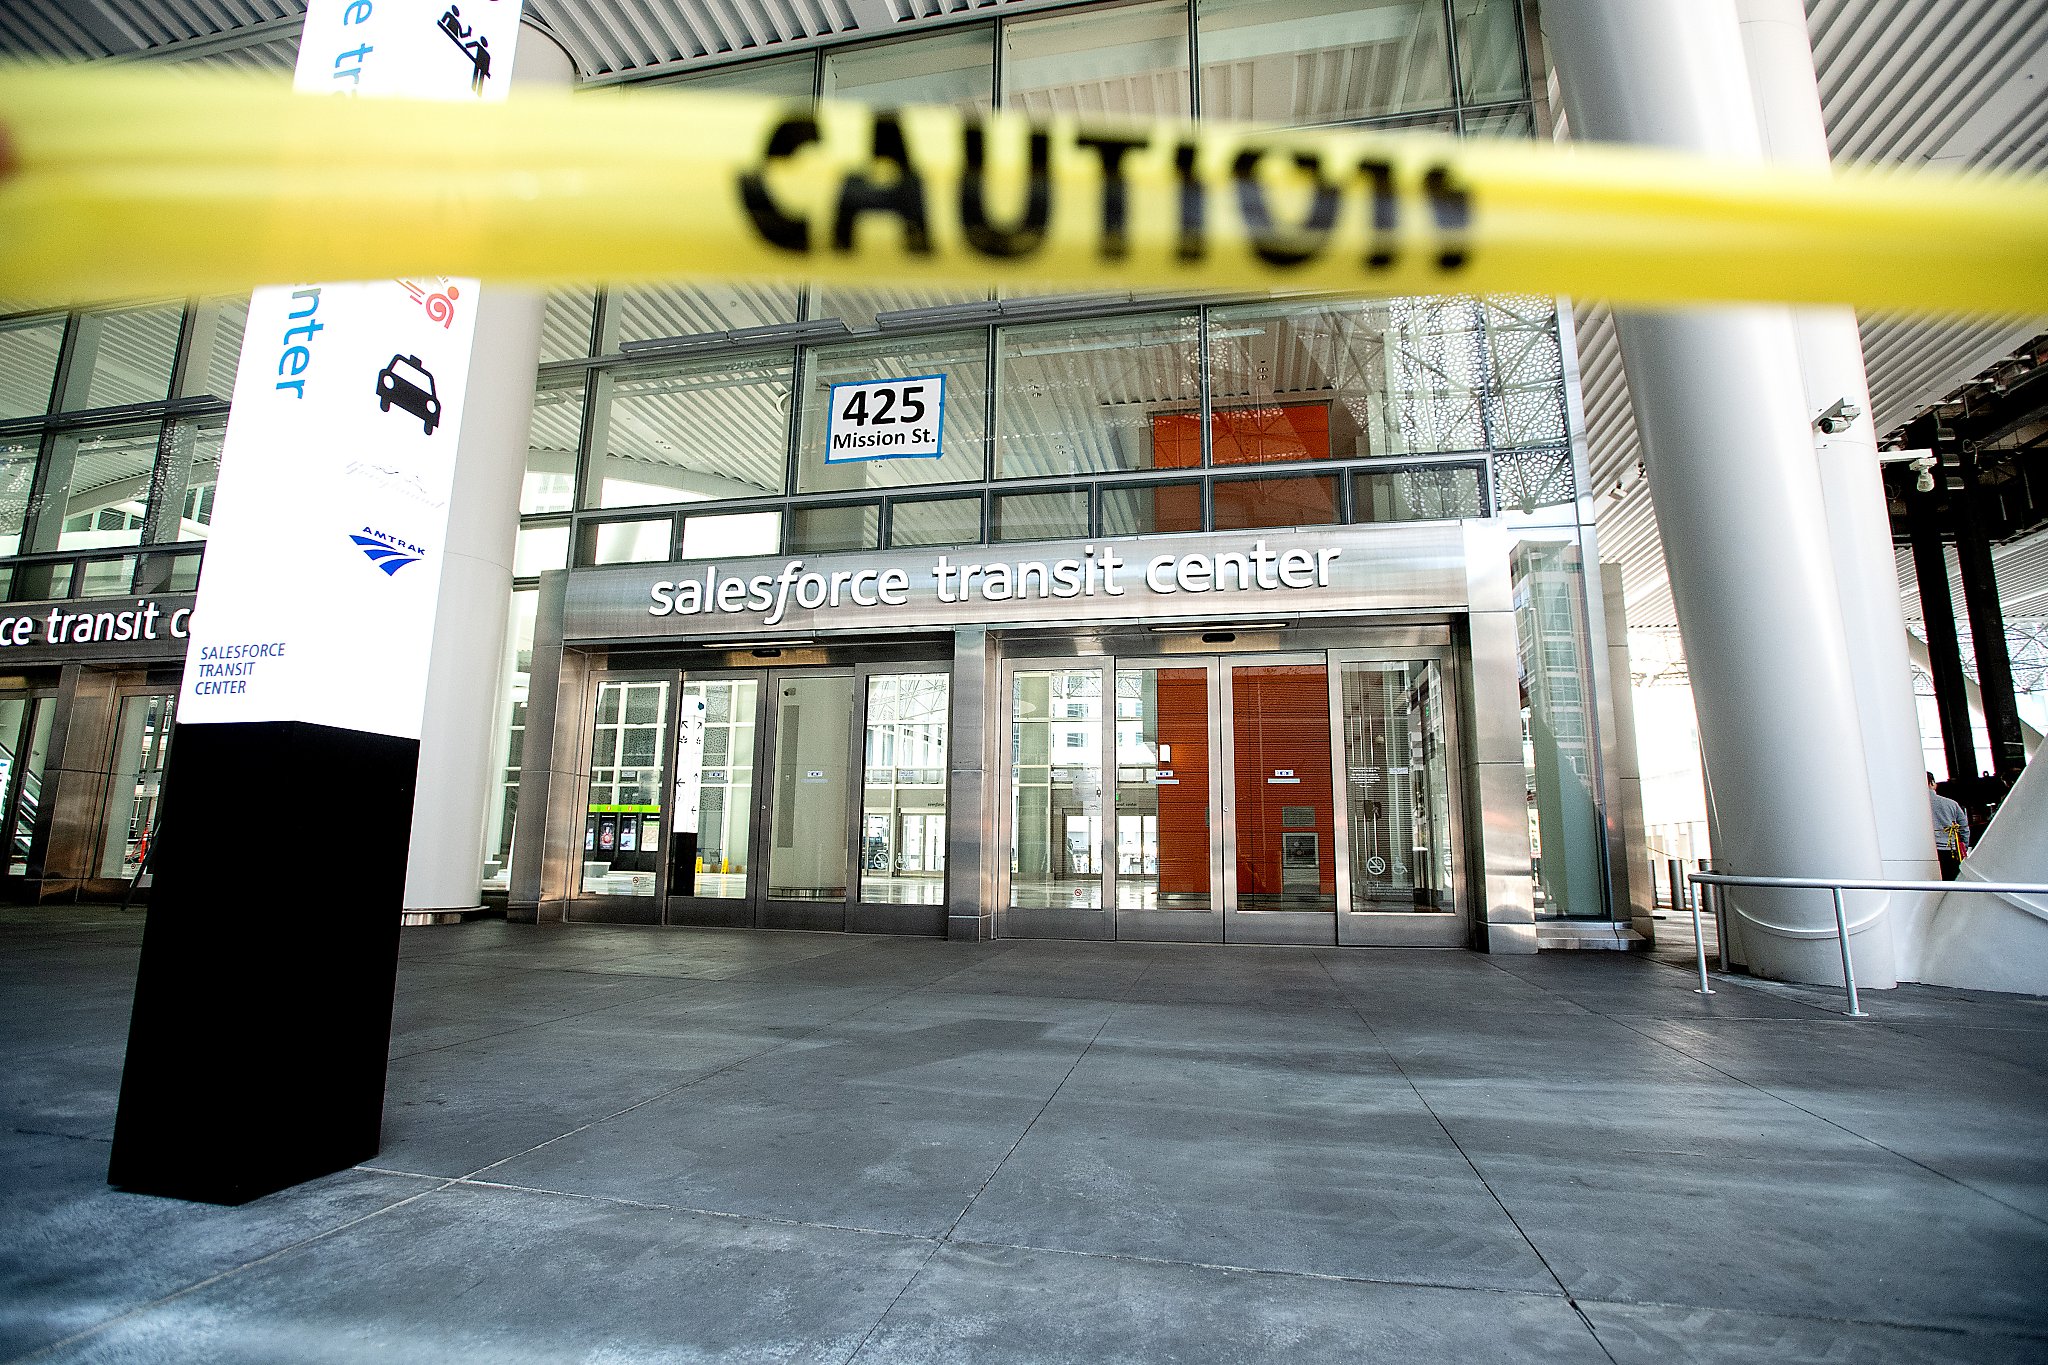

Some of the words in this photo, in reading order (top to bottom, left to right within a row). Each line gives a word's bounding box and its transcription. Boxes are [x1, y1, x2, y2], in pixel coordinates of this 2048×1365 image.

[842, 386, 925, 426] 425
[833, 430, 906, 449] Mission
[911, 428, 936, 444] St.
[362, 526, 426, 556] AMTRAK
[648, 560, 911, 626] salesforce
[931, 544, 1125, 603] transit
[1146, 539, 1343, 595] center
[46, 600, 160, 645] transit
[200, 642, 286, 660] SALESFORCE
[199, 661, 257, 678] TRANSIT
[195, 680, 247, 696] CENTER
